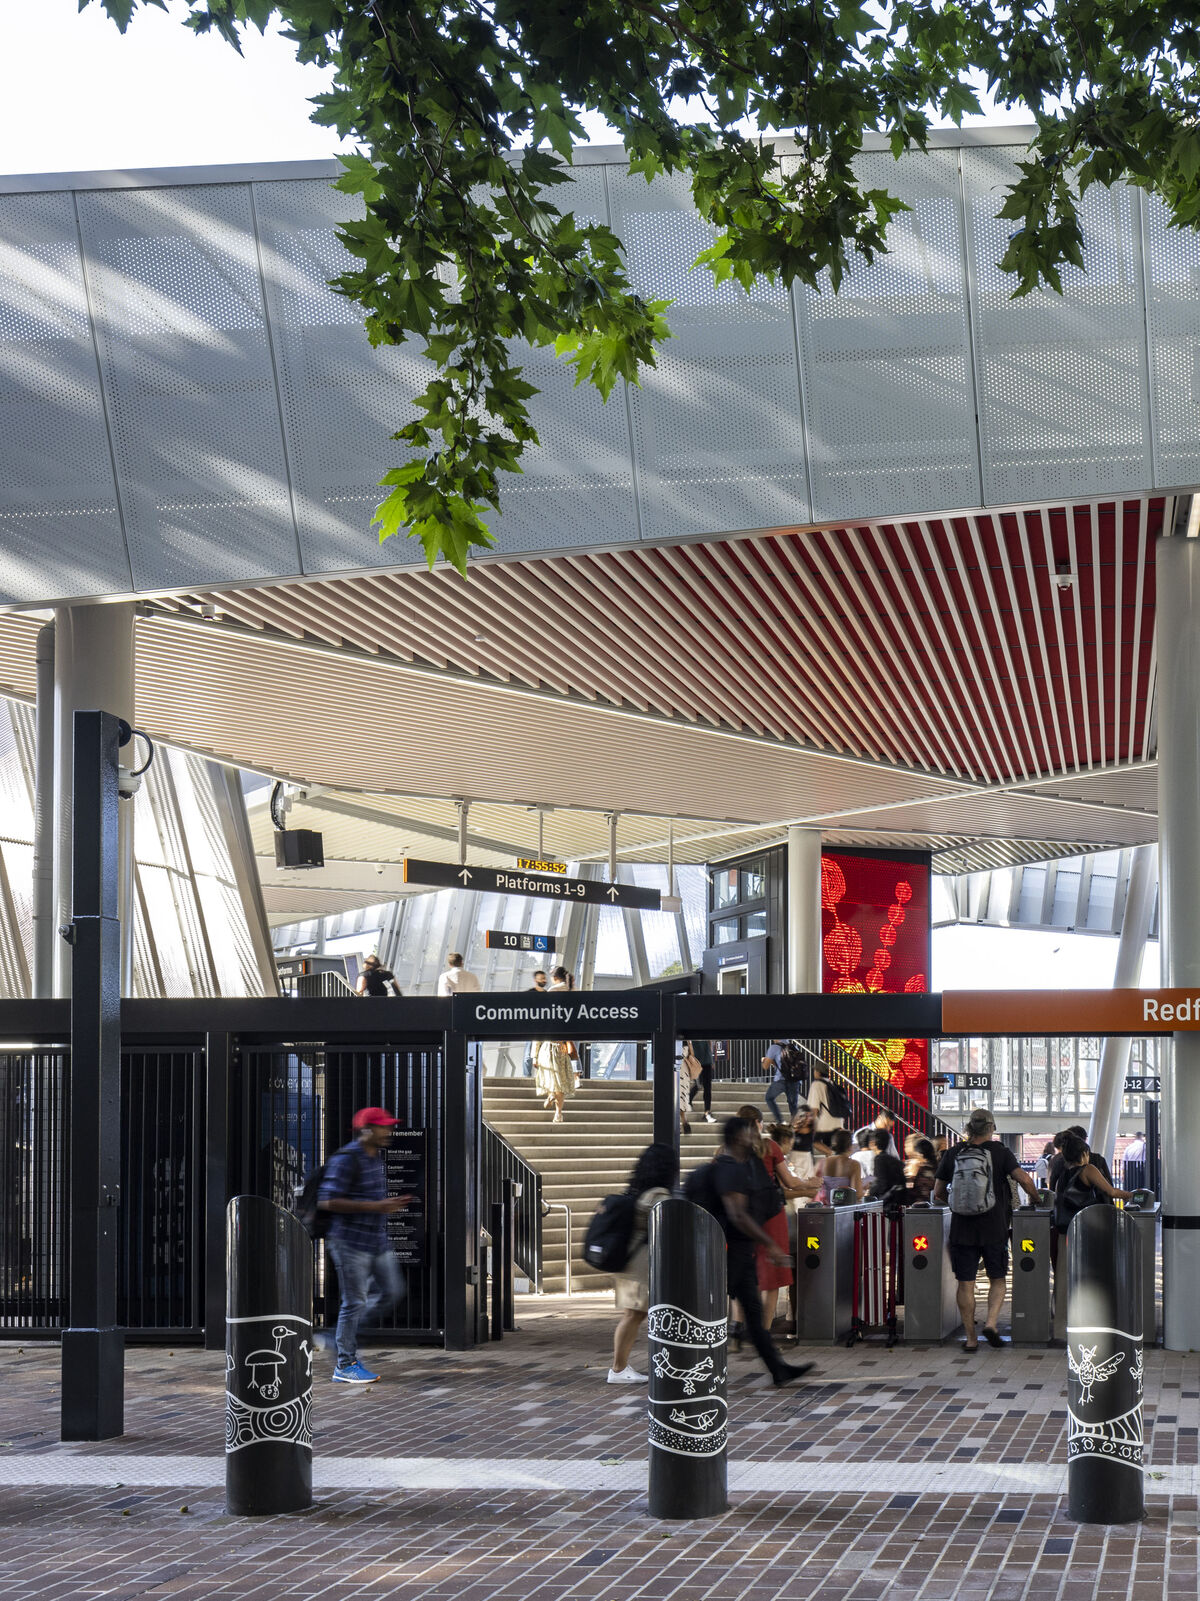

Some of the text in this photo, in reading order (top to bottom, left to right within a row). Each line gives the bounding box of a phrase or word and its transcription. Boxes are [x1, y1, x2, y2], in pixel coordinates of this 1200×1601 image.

[518, 858, 567, 874] 17:55:52
[496, 874, 586, 897] Platforms 1-9
[503, 935, 518, 946] 10
[475, 1004, 639, 1023] Community Access
[968, 1076, 988, 1087] 1-10
[1123, 1079, 1142, 1089] 0-12
